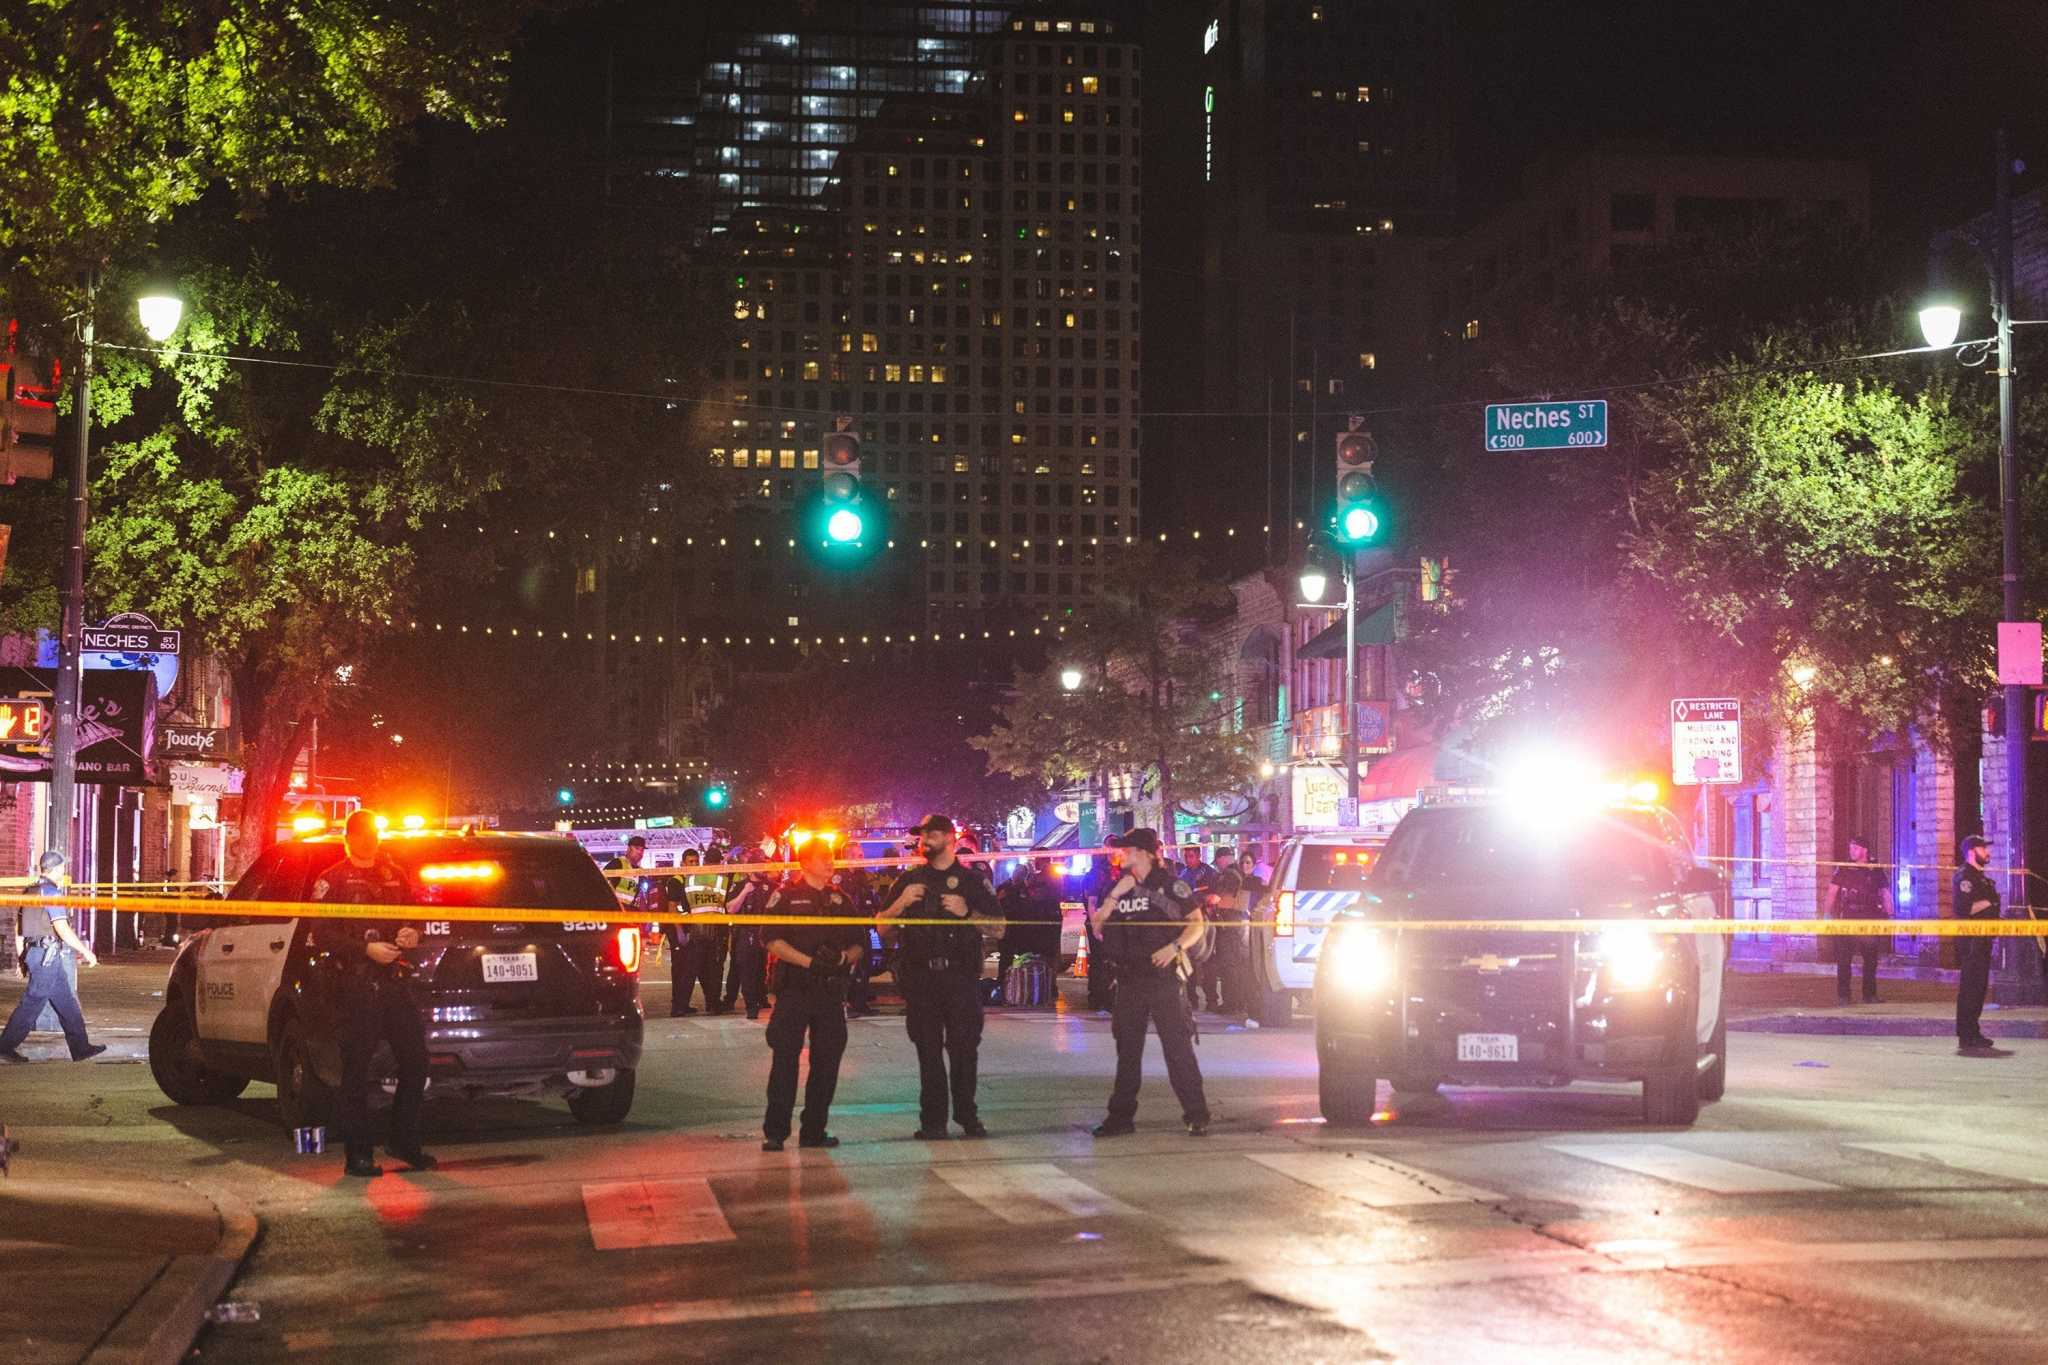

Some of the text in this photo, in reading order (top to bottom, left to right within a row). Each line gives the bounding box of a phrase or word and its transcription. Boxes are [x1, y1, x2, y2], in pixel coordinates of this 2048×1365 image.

[1497, 404, 1595, 430] Neches ST
[1500, 431, 1593, 448] 500 600
[84, 633, 149, 648] NECHES
[1689, 702, 1738, 710] RESTRICTED
[164, 729, 217, 751] Touché
[107, 763, 131, 771] BAR
[694, 893, 719, 904] FIRE
